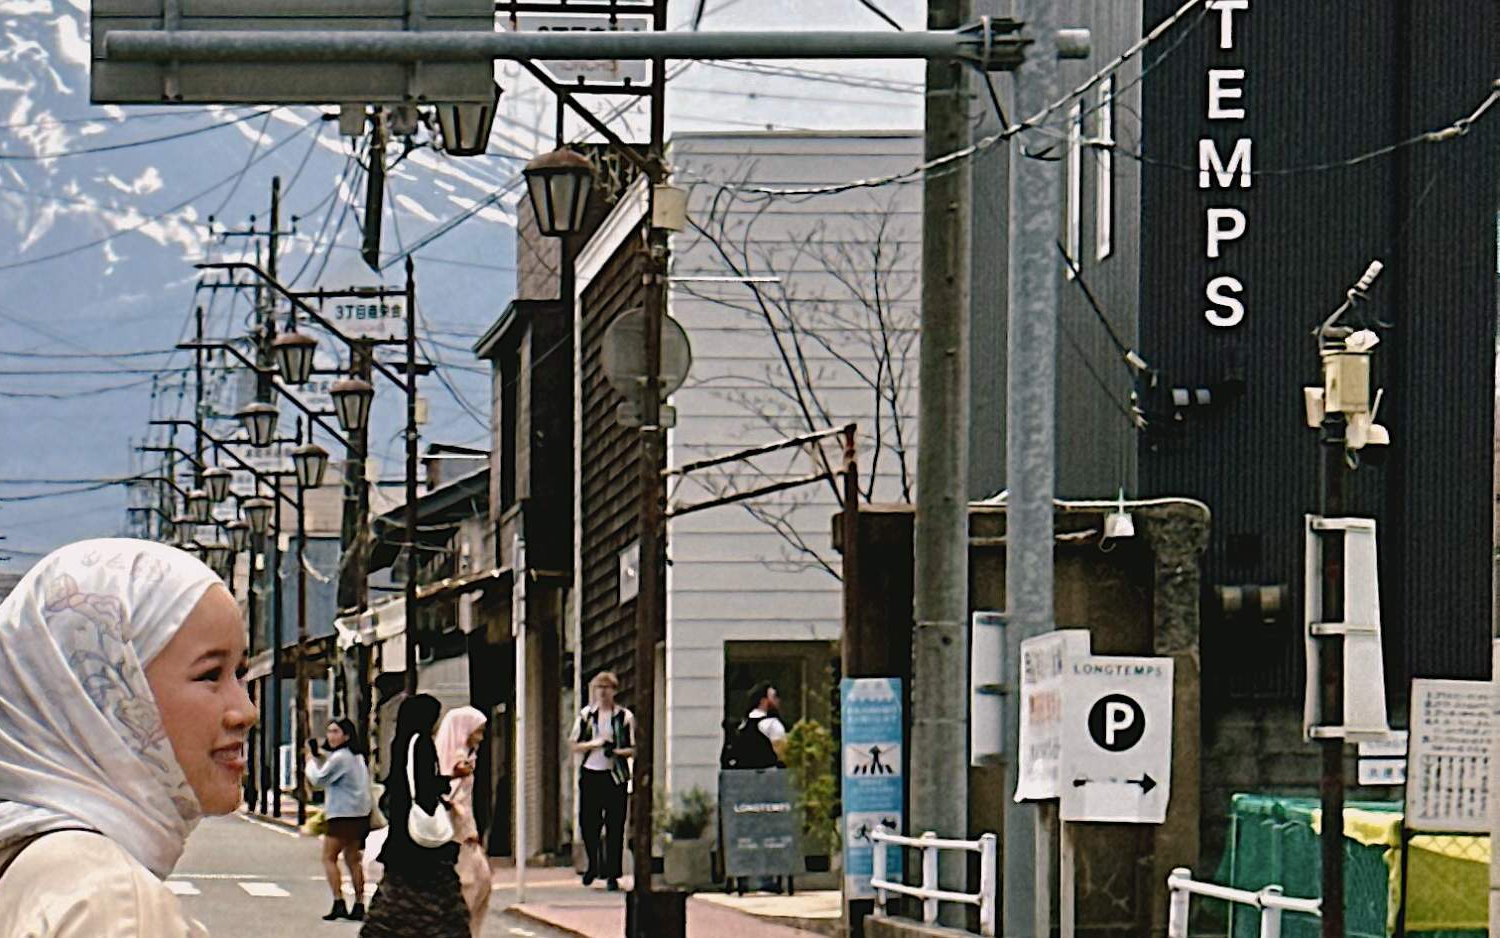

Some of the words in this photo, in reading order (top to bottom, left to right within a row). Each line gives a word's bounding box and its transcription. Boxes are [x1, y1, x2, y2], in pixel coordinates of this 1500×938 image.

[1199, 0, 1251, 327] TEMPS
[1073, 664, 1163, 676] LONGTEMPS
[1105, 702, 1135, 745] P
